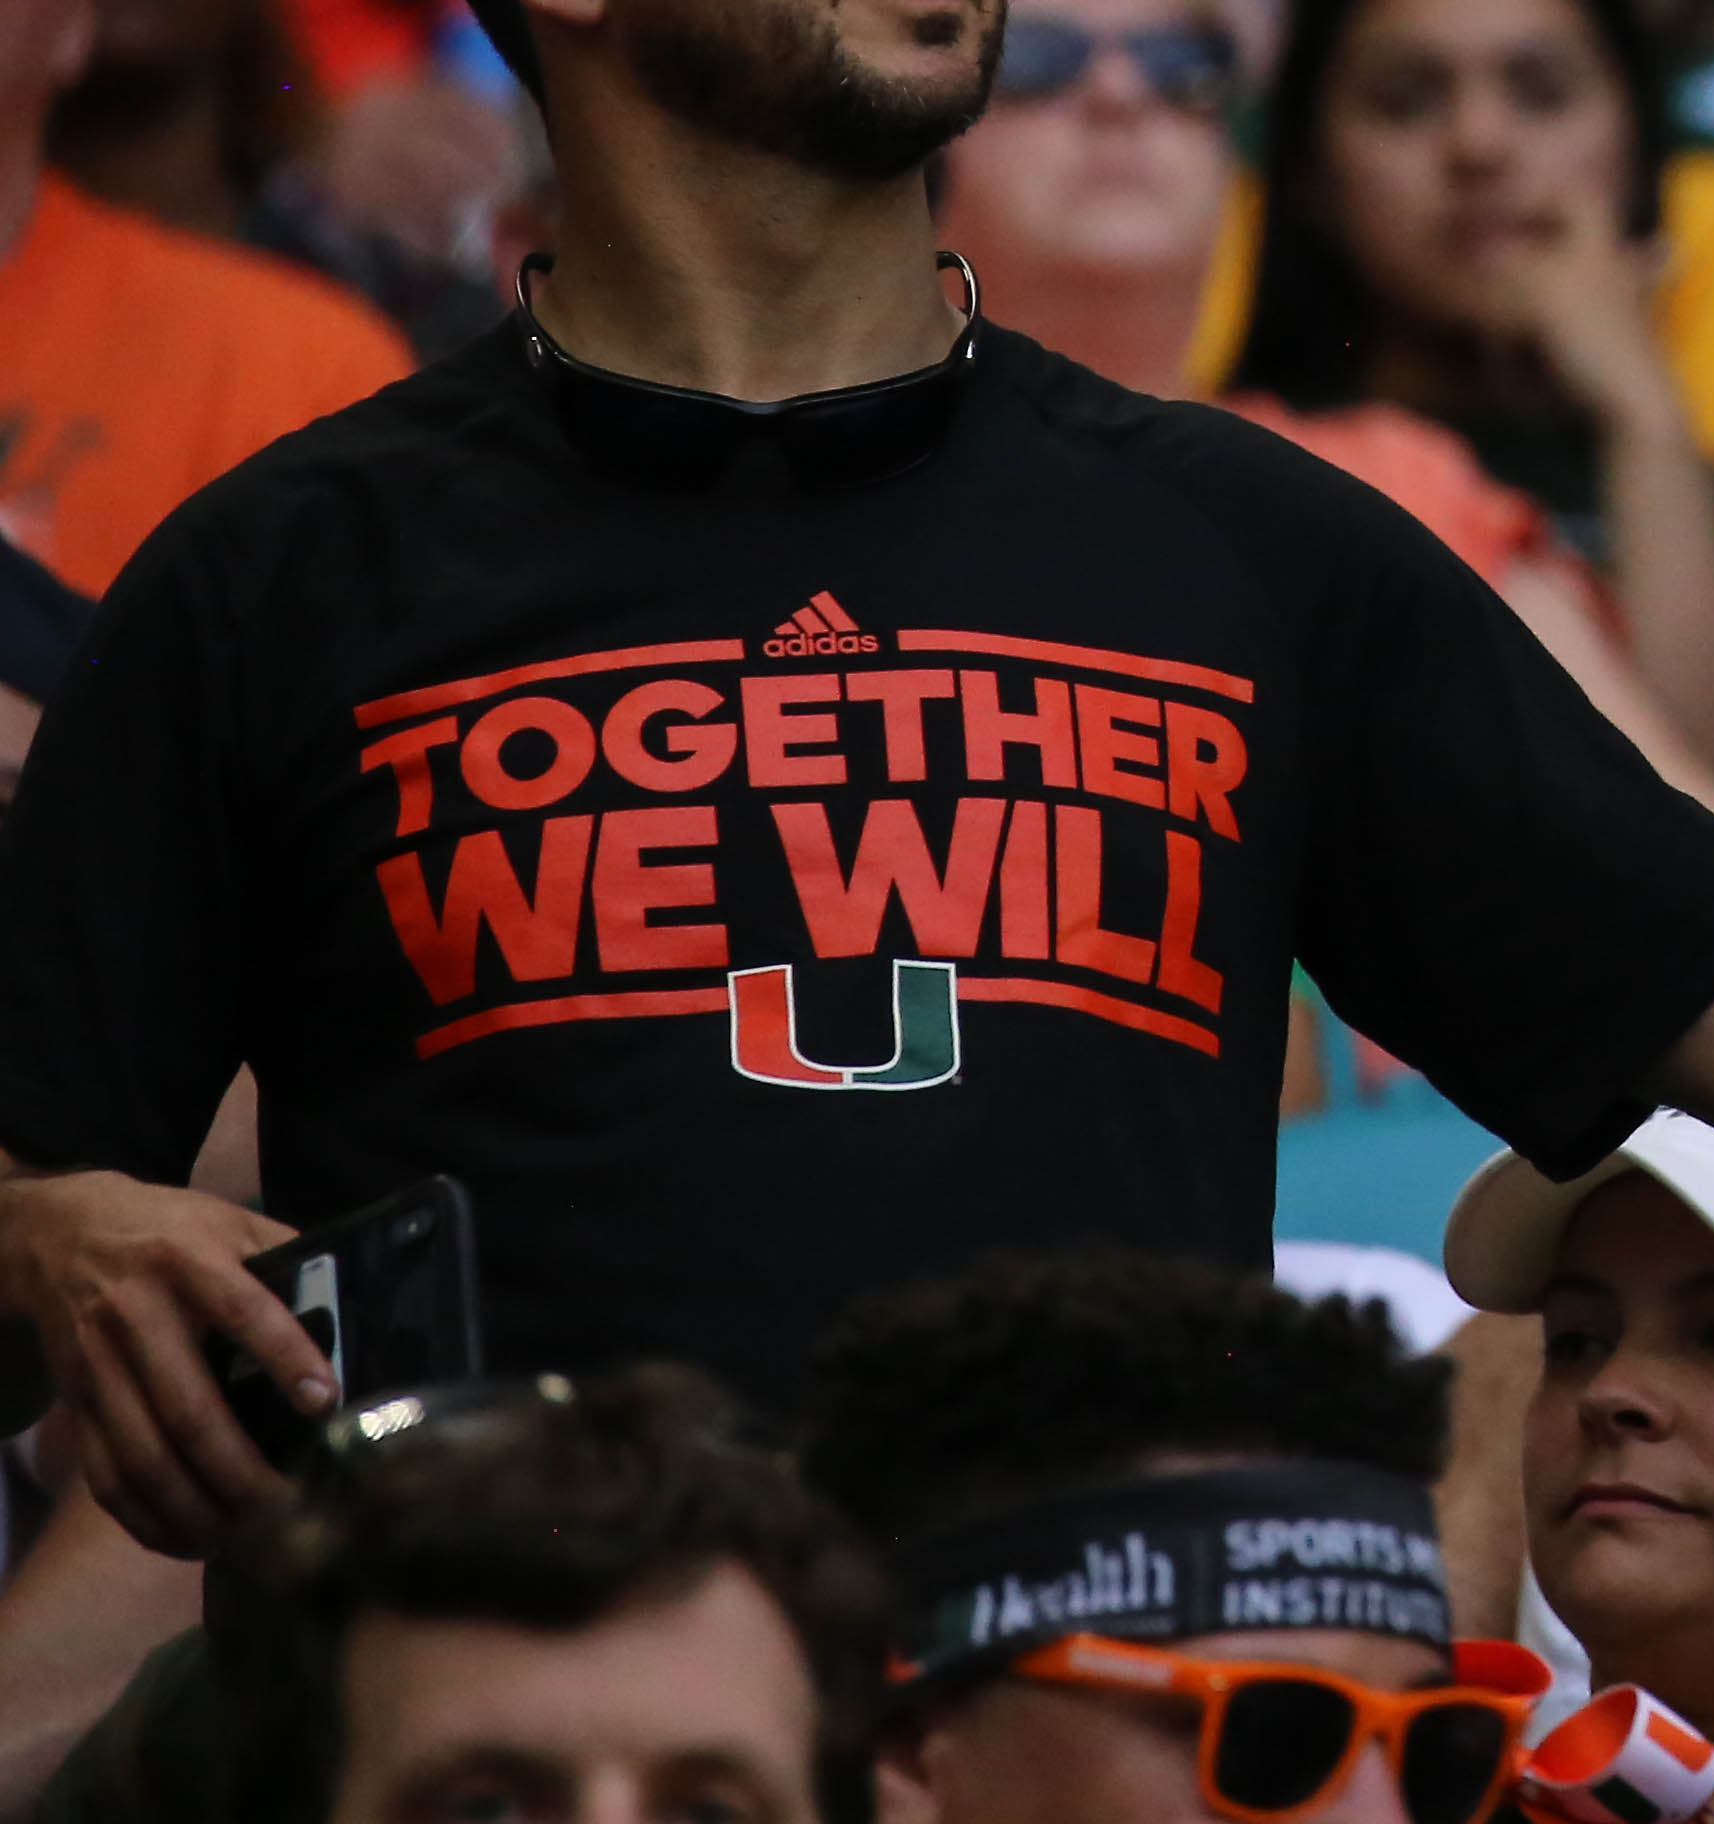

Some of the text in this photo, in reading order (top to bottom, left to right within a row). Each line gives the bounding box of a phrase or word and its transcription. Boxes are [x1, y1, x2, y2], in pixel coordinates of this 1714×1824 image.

[762, 632, 880, 658] adidas
[359, 667, 1249, 844] TOGETHER
[375, 796, 1224, 1016] WE WILL
[727, 959, 960, 1092] U
[1224, 1518, 1401, 1574] SPORTS
